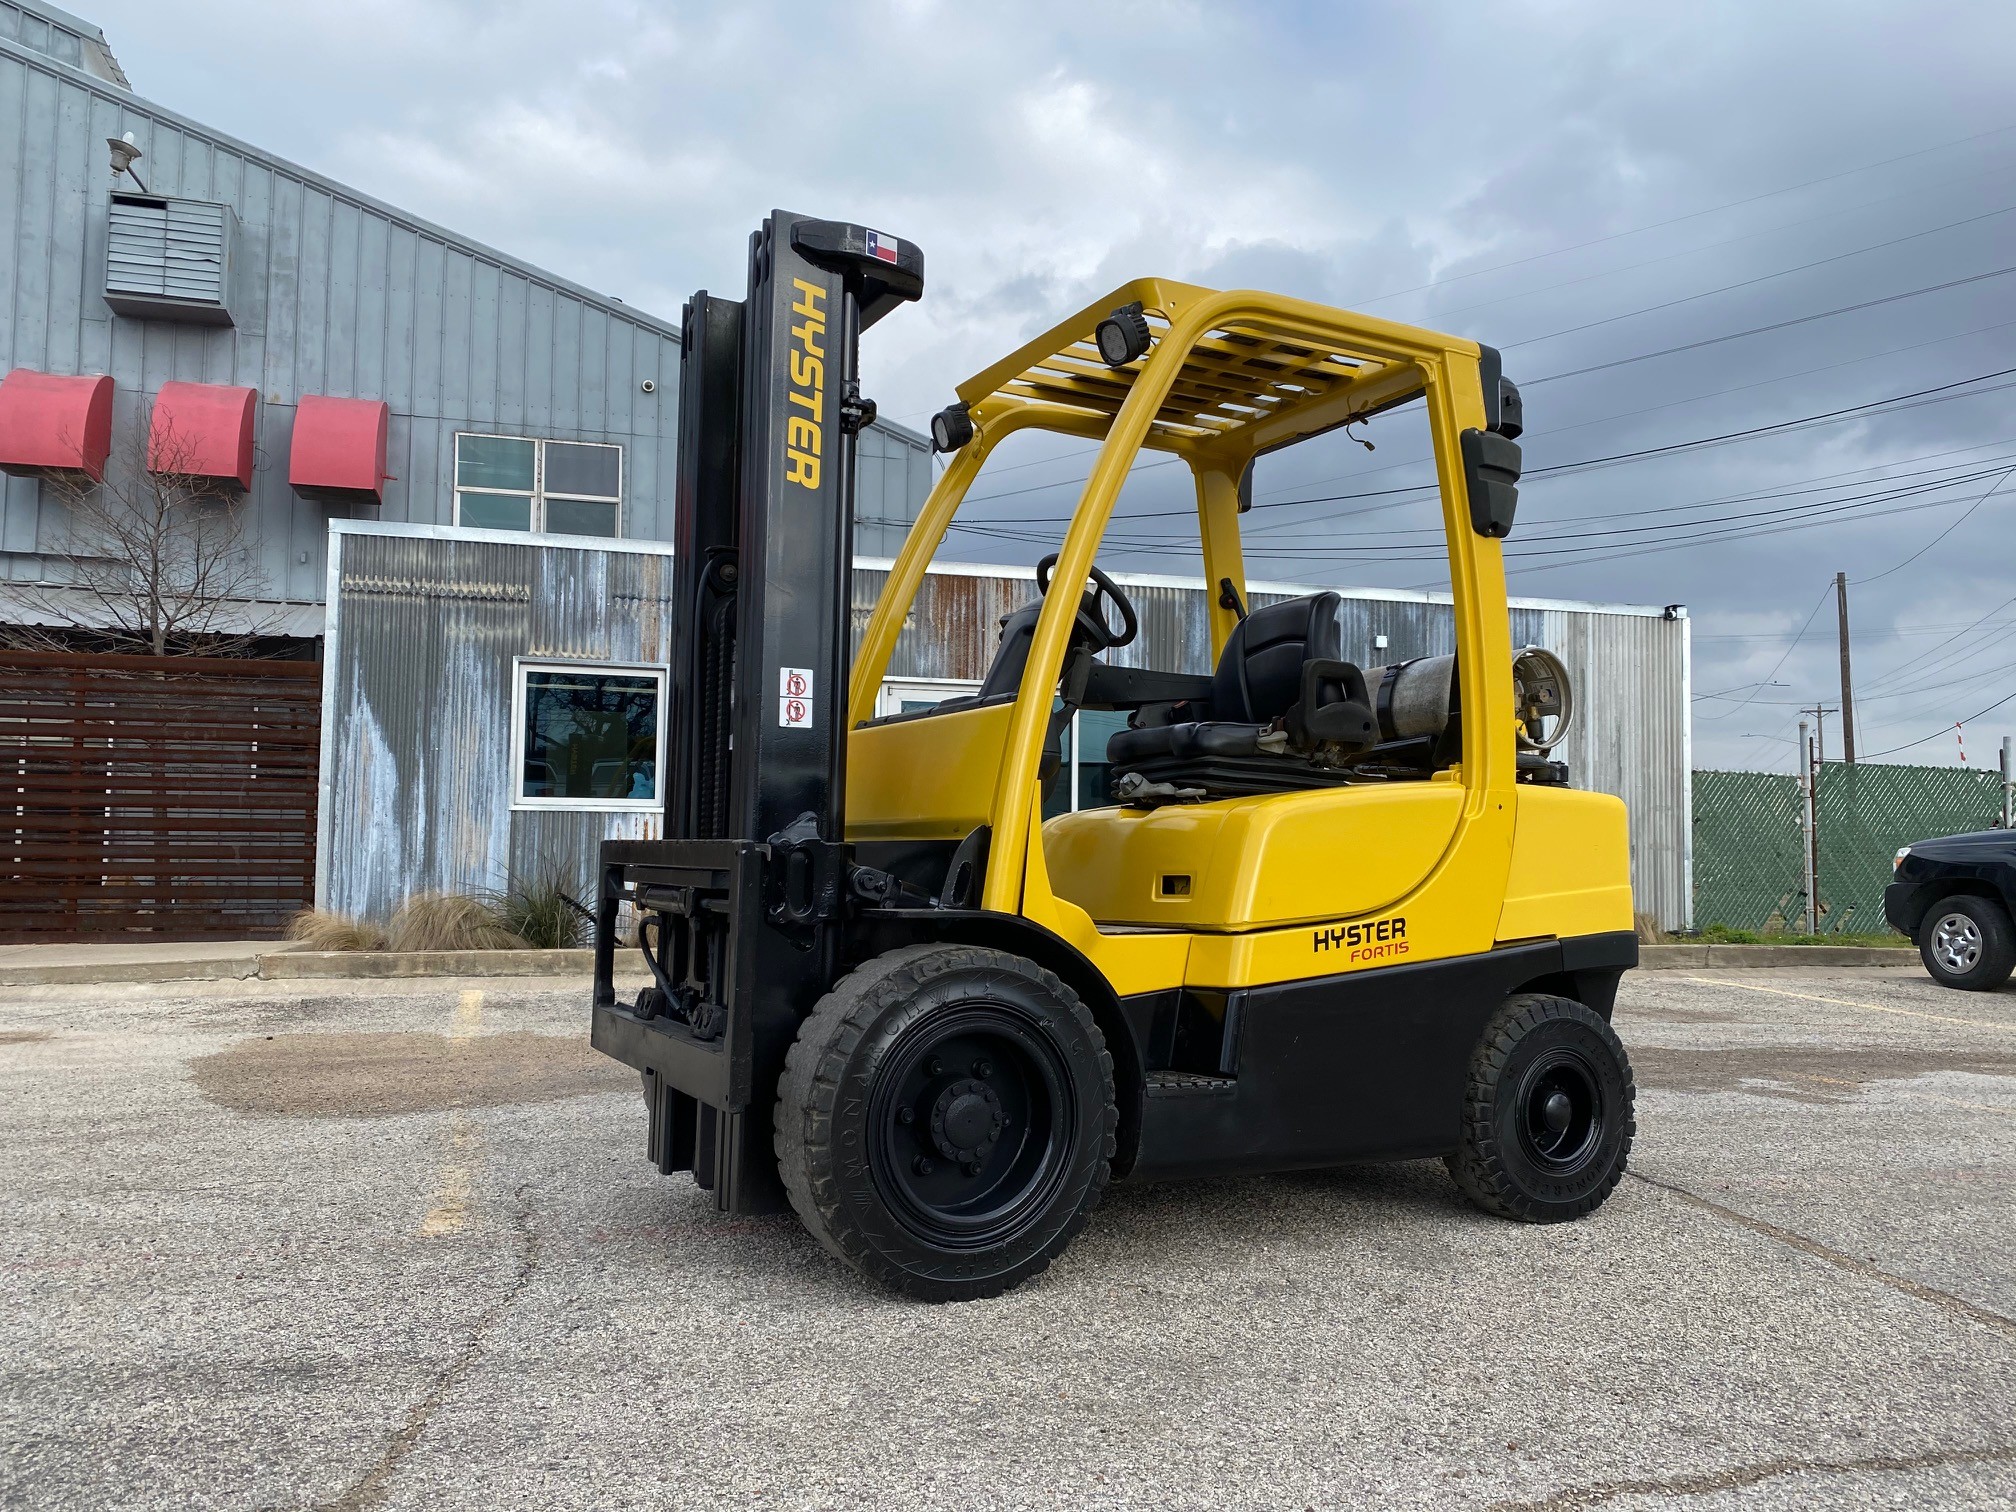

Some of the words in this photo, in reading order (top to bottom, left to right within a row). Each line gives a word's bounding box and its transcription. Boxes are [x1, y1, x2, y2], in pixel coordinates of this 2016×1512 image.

[786, 277, 827, 490] HYSTER
[1313, 917, 1406, 953] HYSTER
[1350, 941, 1410, 963] FORTIS
[840, 999, 925, 1179] MONARCH
